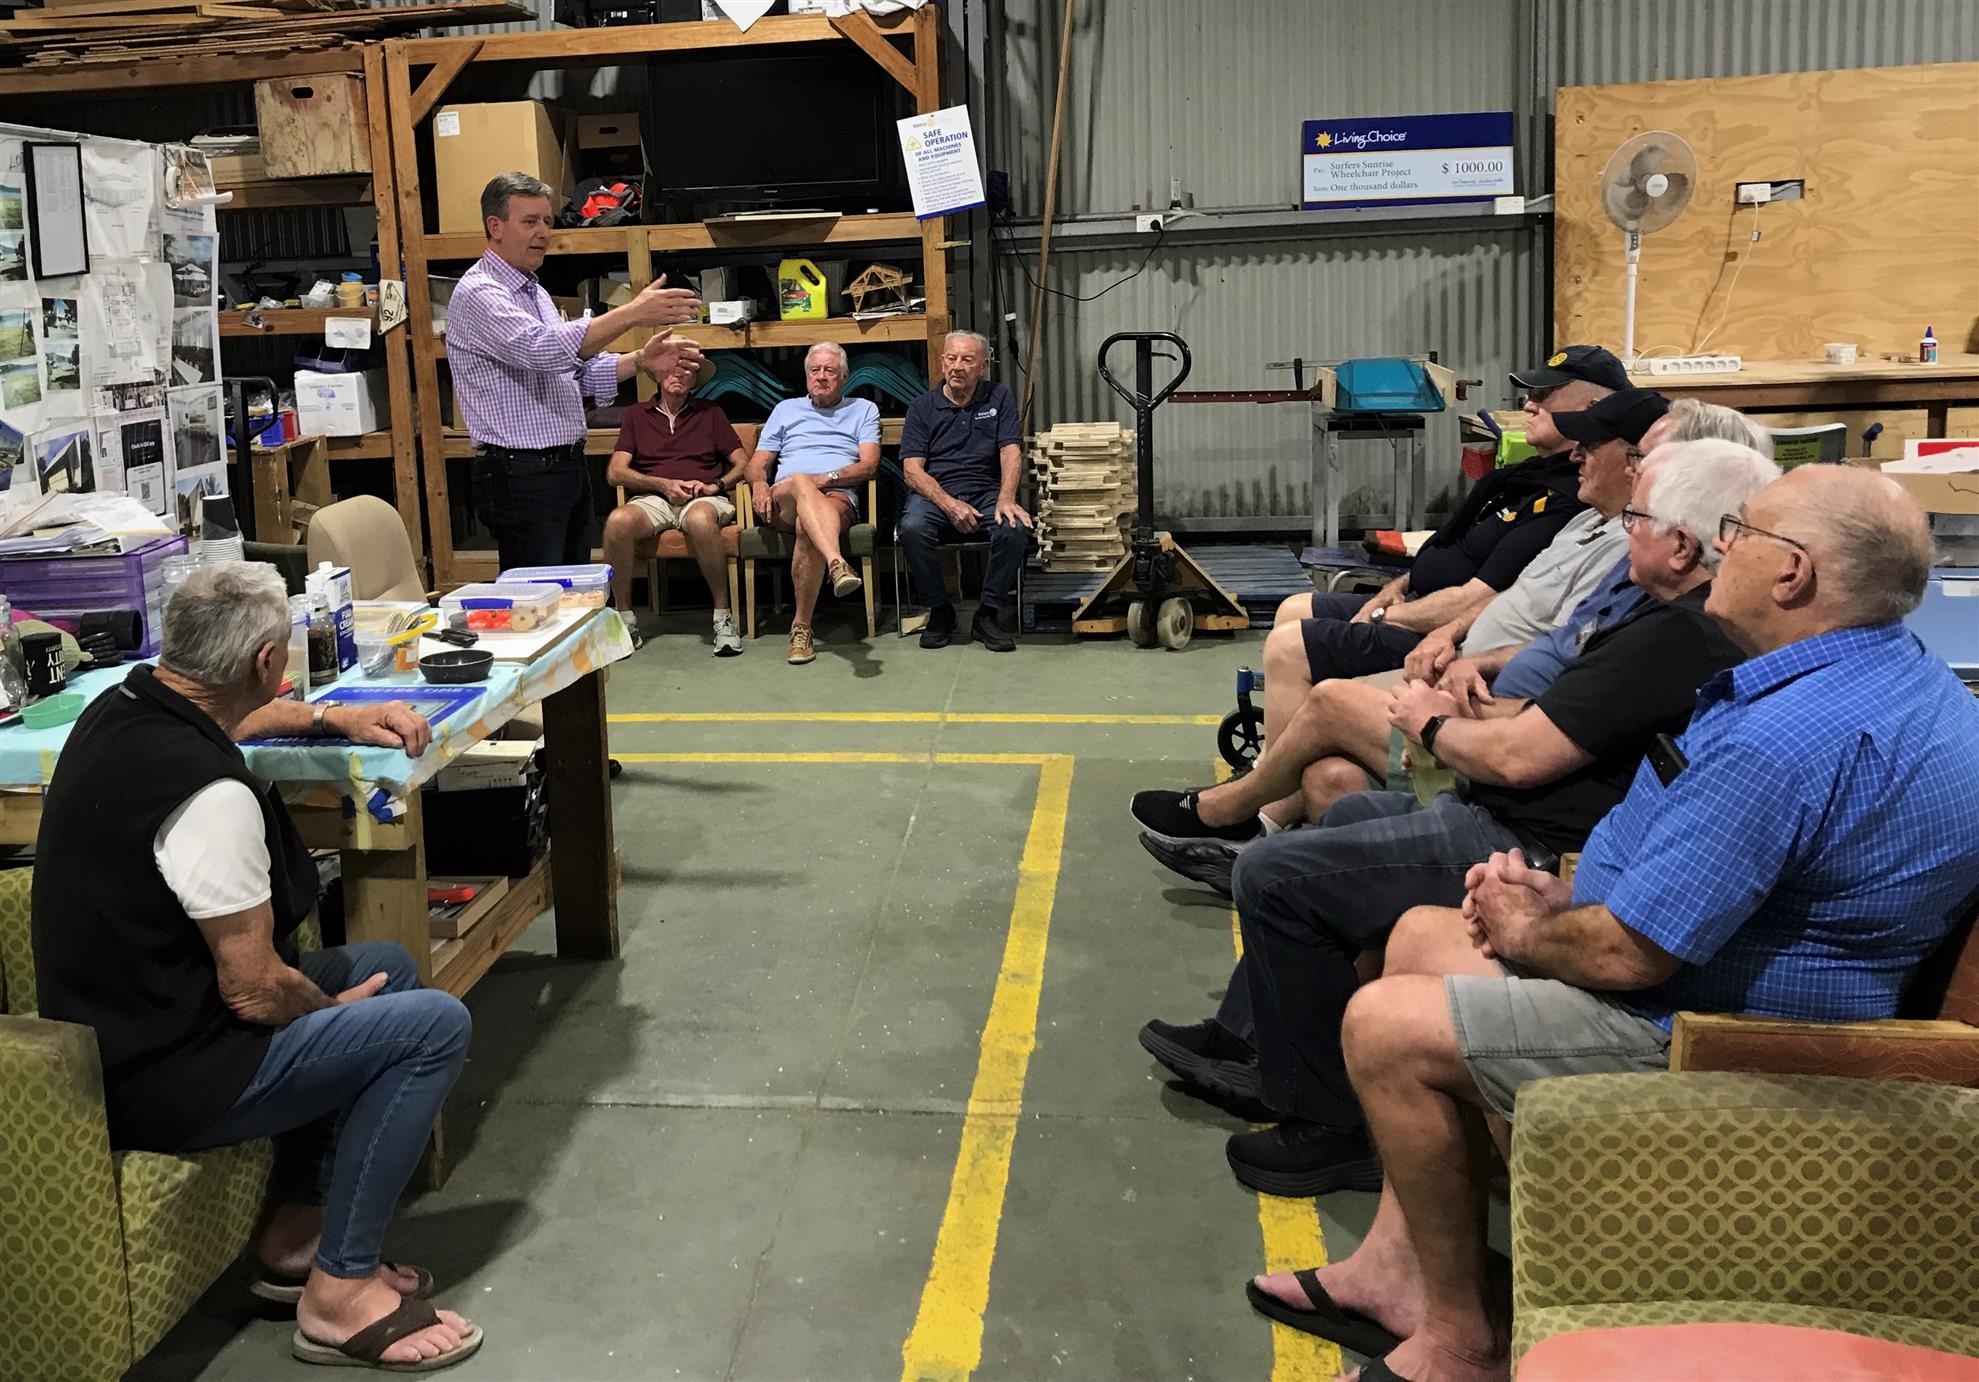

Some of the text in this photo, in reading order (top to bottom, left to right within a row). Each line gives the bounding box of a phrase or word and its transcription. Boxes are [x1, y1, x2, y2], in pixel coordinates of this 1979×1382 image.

[923, 128, 942, 139] SAFE
[924, 131, 968, 147] OPERATION
[1334, 130, 1405, 149] Living Choice
[931, 148, 961, 160] EQUIPMENT
[934, 143, 962, 153] MACHINES
[1330, 160, 1394, 170] Surfers Sunrise
[1441, 160, 1503, 174] $ 1000.00
[1330, 168, 1411, 178] Wheelchair Project
[1330, 183, 1349, 192] One
[1350, 181, 1388, 191] thousand
[1390, 180, 1418, 189] dollars
